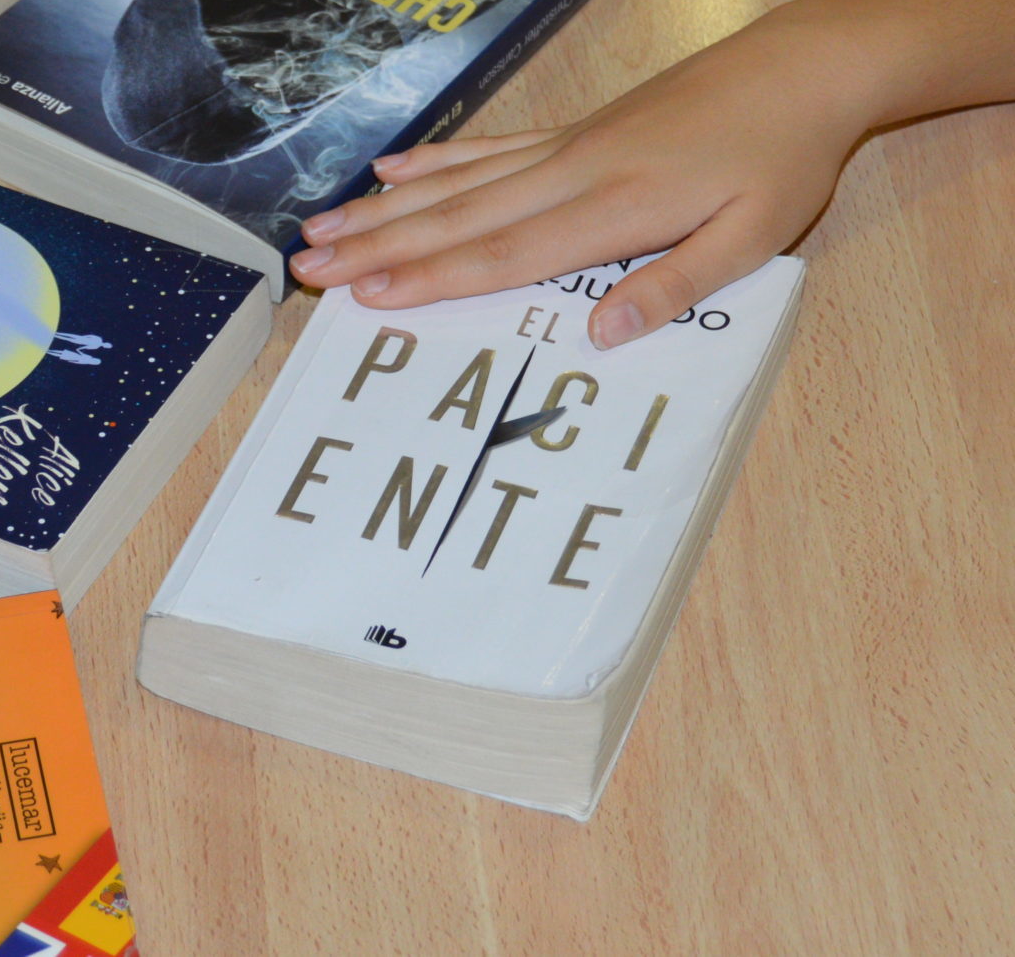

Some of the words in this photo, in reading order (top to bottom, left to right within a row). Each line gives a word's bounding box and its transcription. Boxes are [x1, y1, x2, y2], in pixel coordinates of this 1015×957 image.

[10, 79, 74, 117] Alianza
[516, 306, 562, 345] EL
[29, 426, 81, 507] Alice
[8, 742, 43, 832] lucemar
